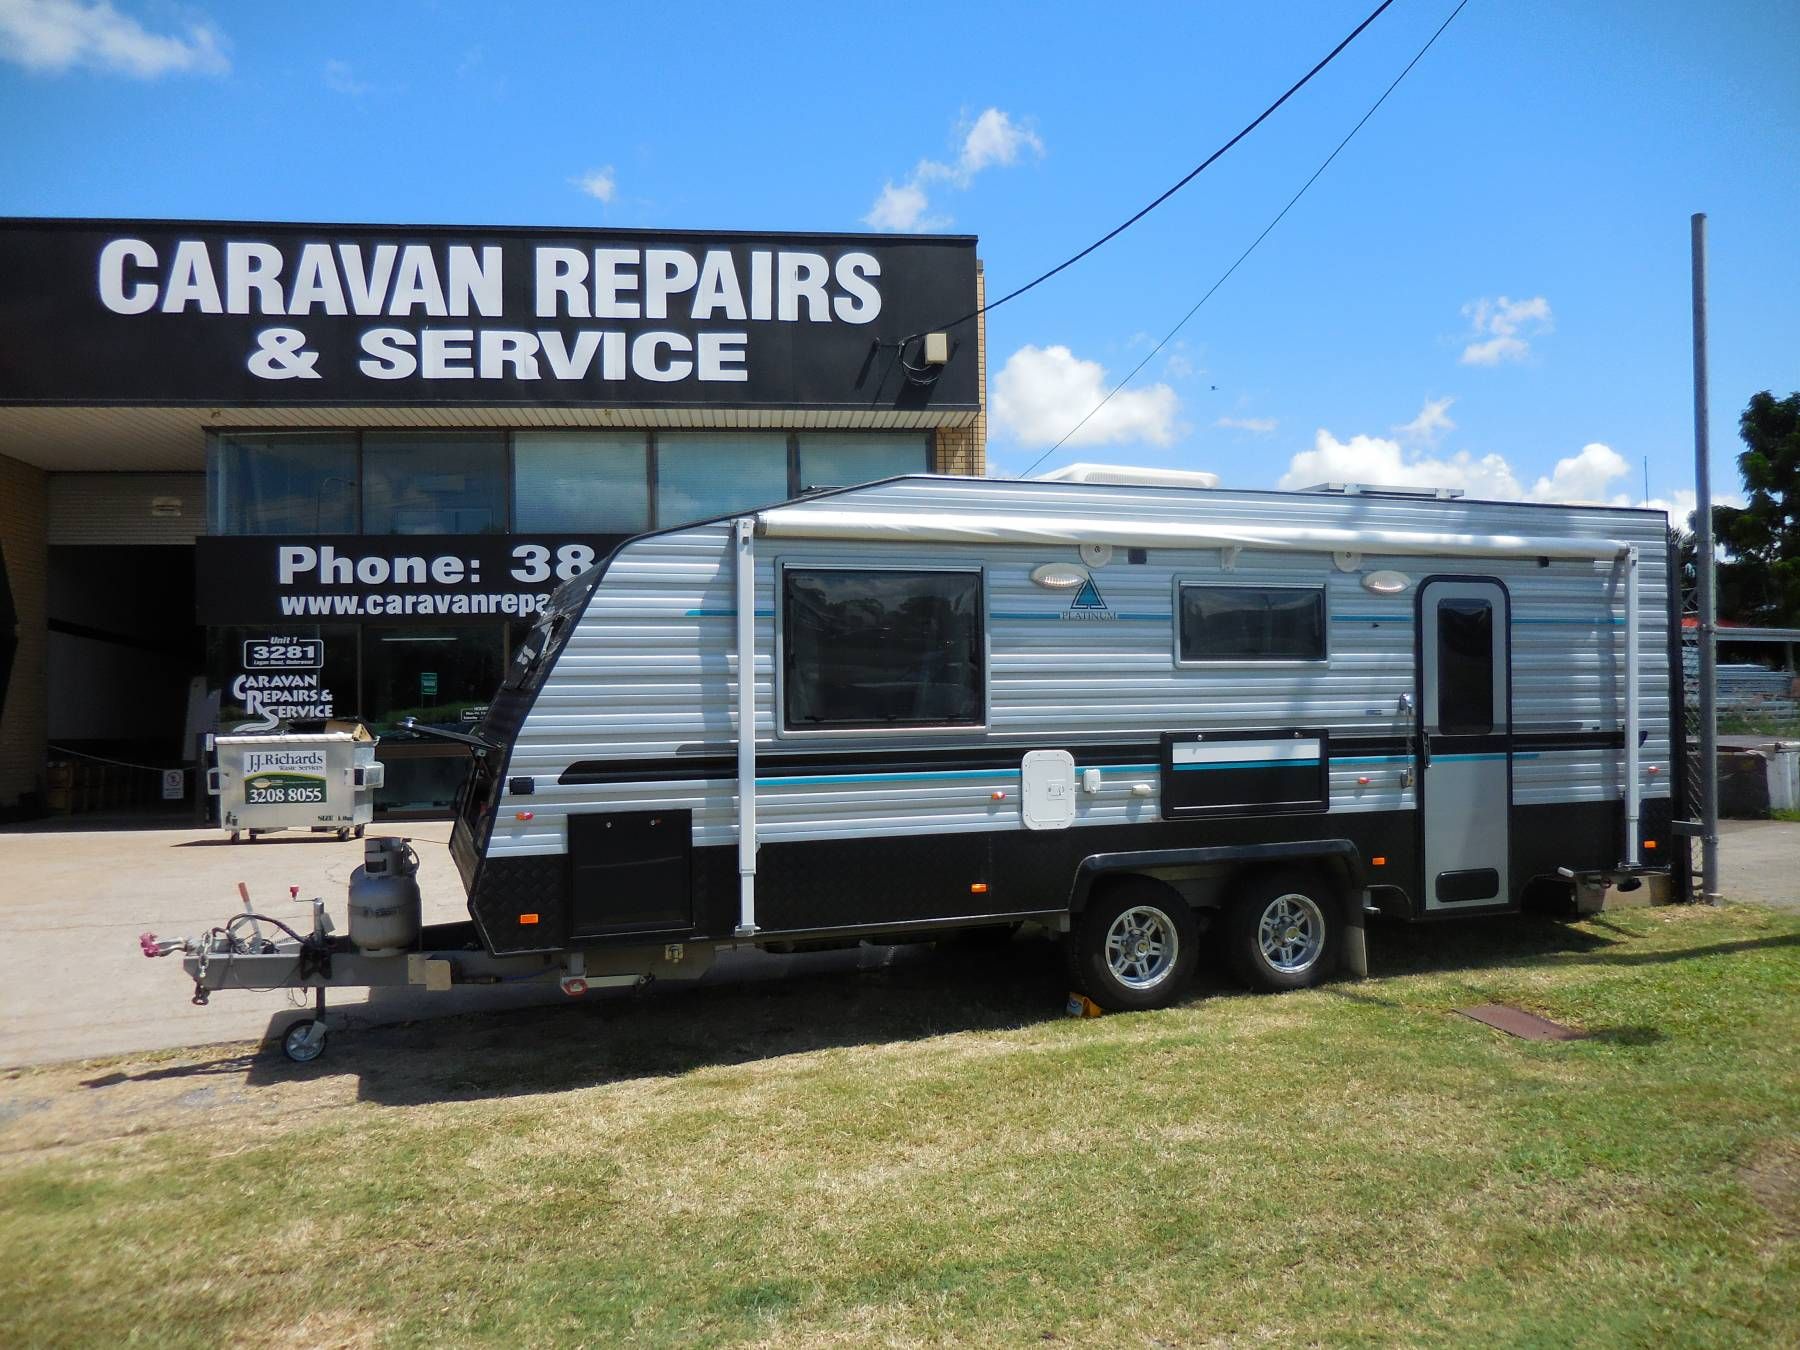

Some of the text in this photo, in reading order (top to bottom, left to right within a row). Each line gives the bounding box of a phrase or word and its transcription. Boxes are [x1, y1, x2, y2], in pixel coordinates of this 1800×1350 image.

[98, 238, 882, 324] CARAVAN REPAIRS
[247, 326, 748, 382] & SERVICE
[279, 544, 595, 585] Phone: 38
[1062, 611, 1118, 621] PLATINUM
[253, 645, 315, 659] 3281
[270, 636, 290, 645] Unit
[233, 674, 317, 700] CARAVAN
[246, 689, 333, 715] REPAIRS &
[232, 704, 333, 732] SERVICE
[249, 787, 322, 803] 3208 8055
